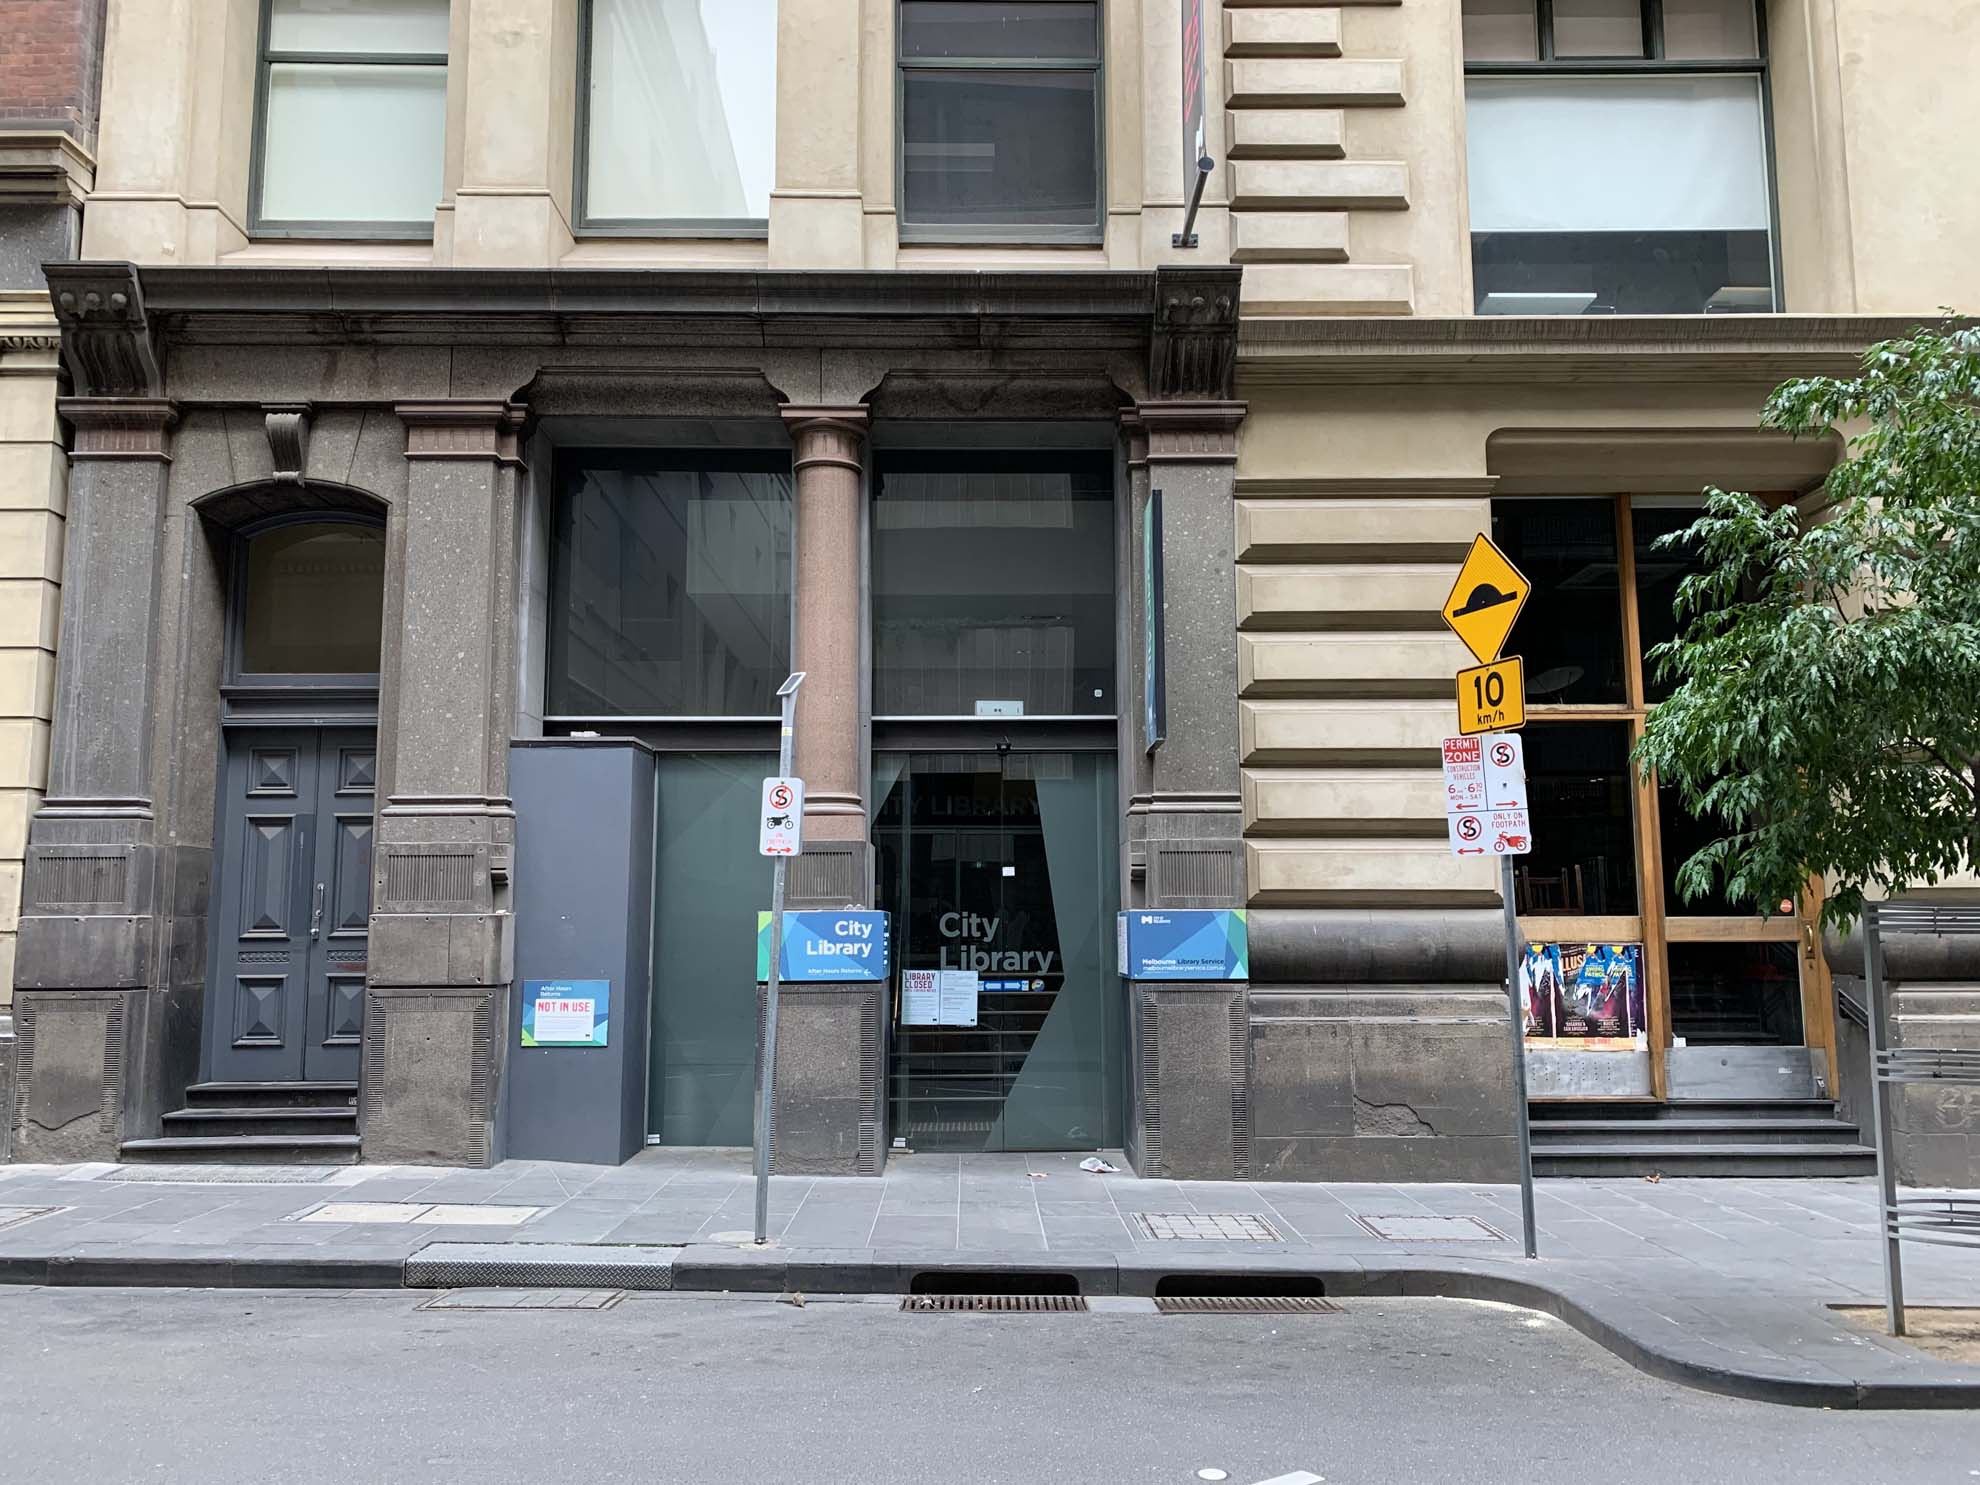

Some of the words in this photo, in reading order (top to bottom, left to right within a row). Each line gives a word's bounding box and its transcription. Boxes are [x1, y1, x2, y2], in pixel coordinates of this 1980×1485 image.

[1474, 671, 1504, 710] 10
[1477, 709, 1505, 725] km/h
[1444, 738, 1479, 750] PERMIT
[1445, 750, 1480, 763] ZONE
[1493, 812, 1511, 821] ONLY
[1513, 812, 1523, 820] ON
[1491, 819, 1526, 829] FOOTPATH
[834, 920, 873, 939] City
[939, 911, 1000, 943] City
[806, 940, 873, 958] Library
[940, 945, 1054, 976] Library
[1177, 958, 1200, 966] Library
[904, 971, 936, 981] LIBRARY
[904, 980, 933, 989] CLOSED
[537, 1001, 557, 1013] NOT
[559, 1001, 569, 1013] IN
[572, 1001, 591, 1013] USE
